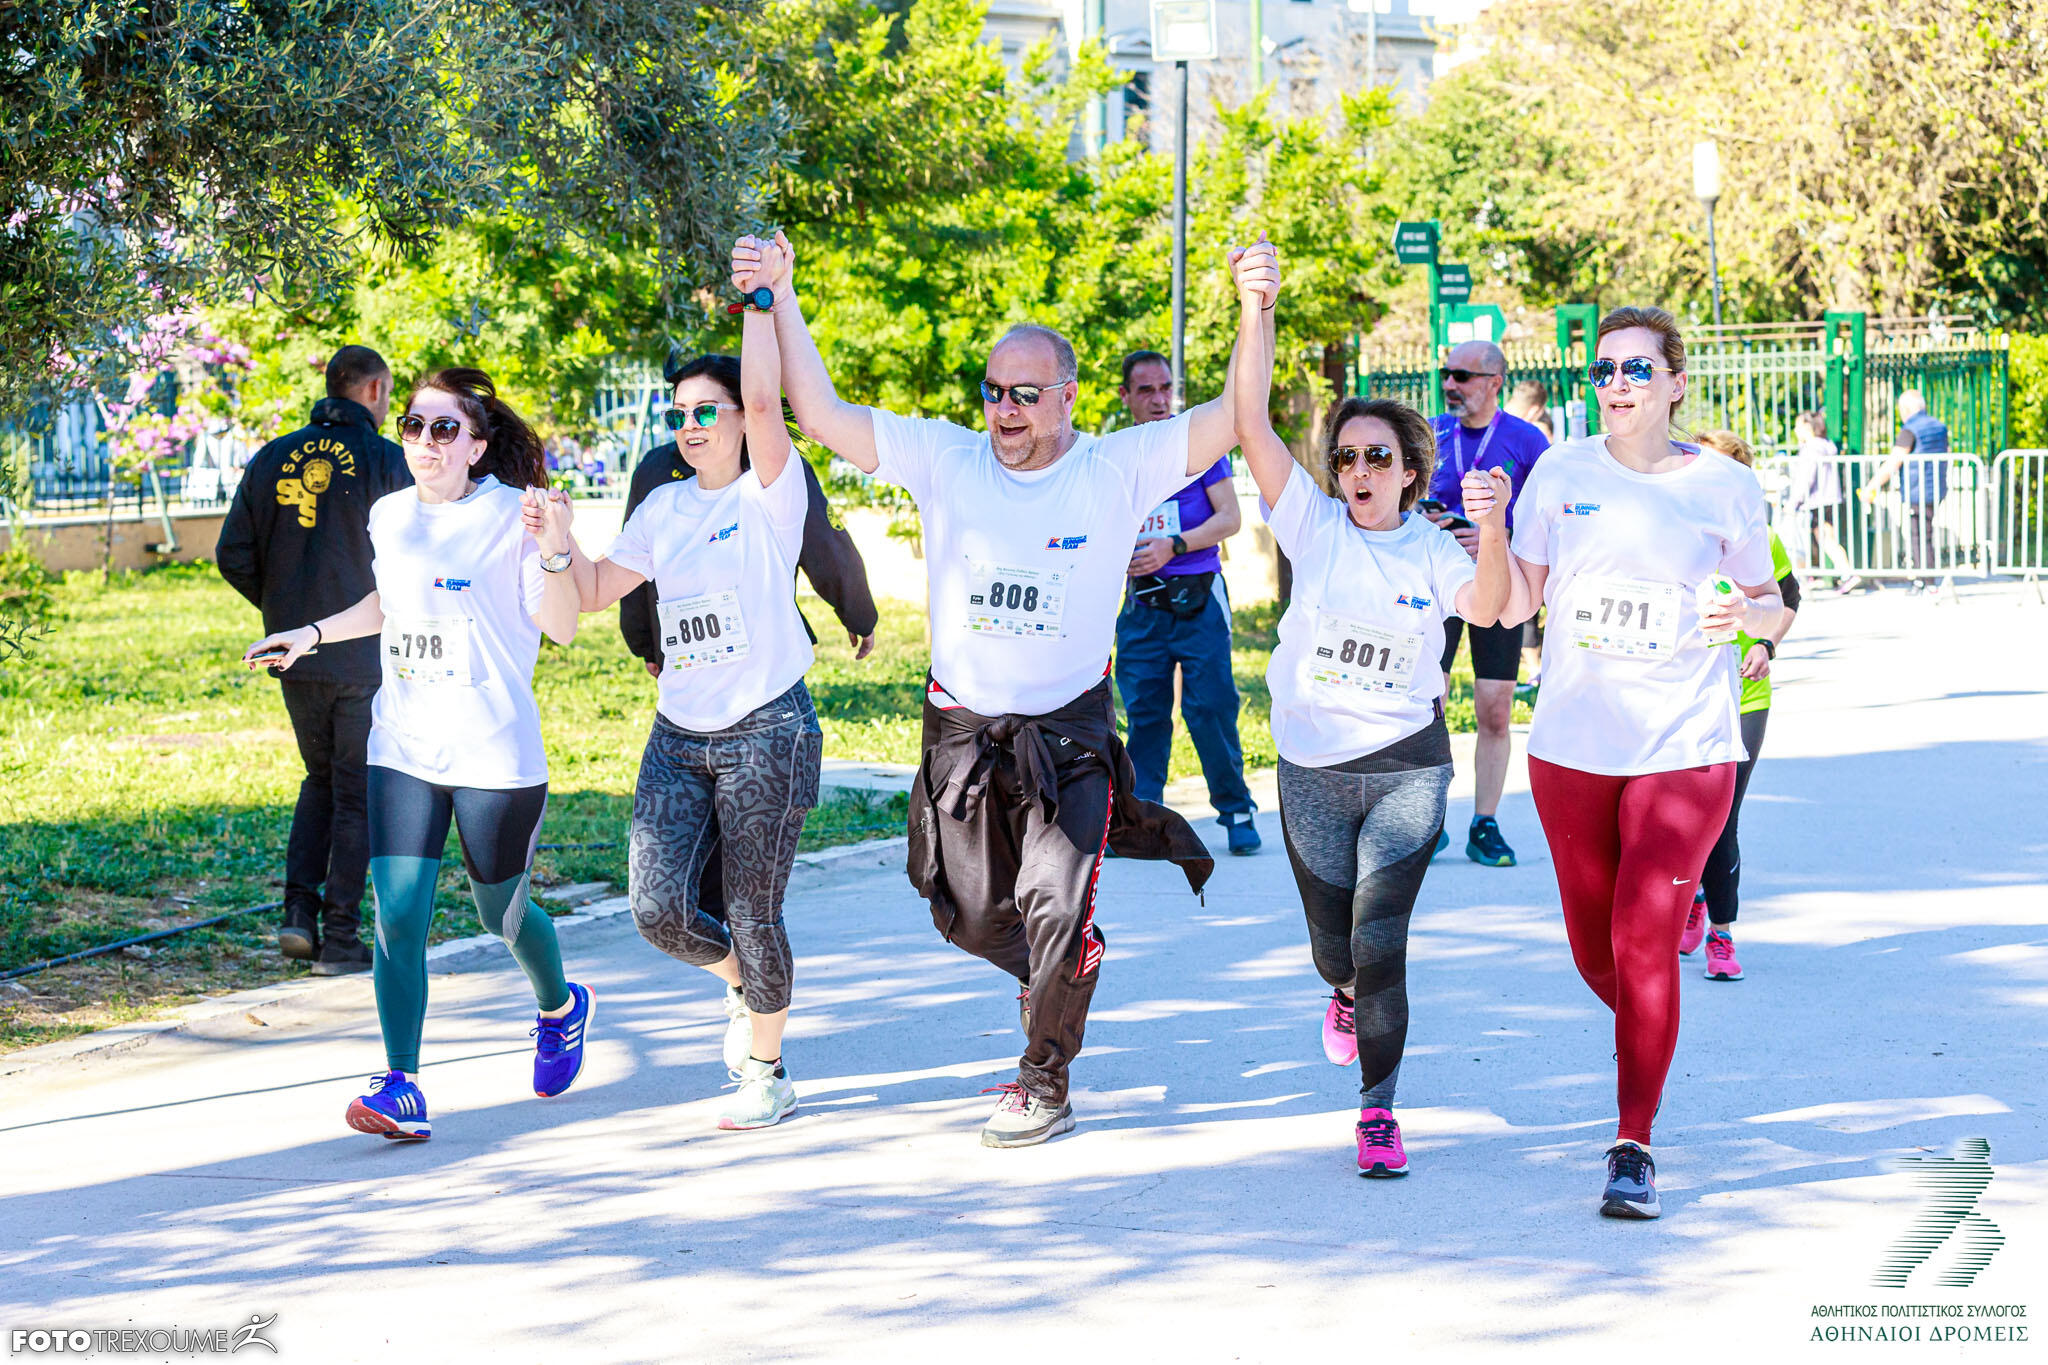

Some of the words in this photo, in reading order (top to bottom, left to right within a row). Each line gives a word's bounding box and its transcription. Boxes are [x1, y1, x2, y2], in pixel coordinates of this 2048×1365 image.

[281, 439, 356, 477] SECURITY
[989, 582, 1039, 612] 808
[679, 613, 721, 644] 800
[1600, 597, 1650, 630] 791
[402, 633, 443, 660] 798
[1340, 638, 1391, 671] 801
